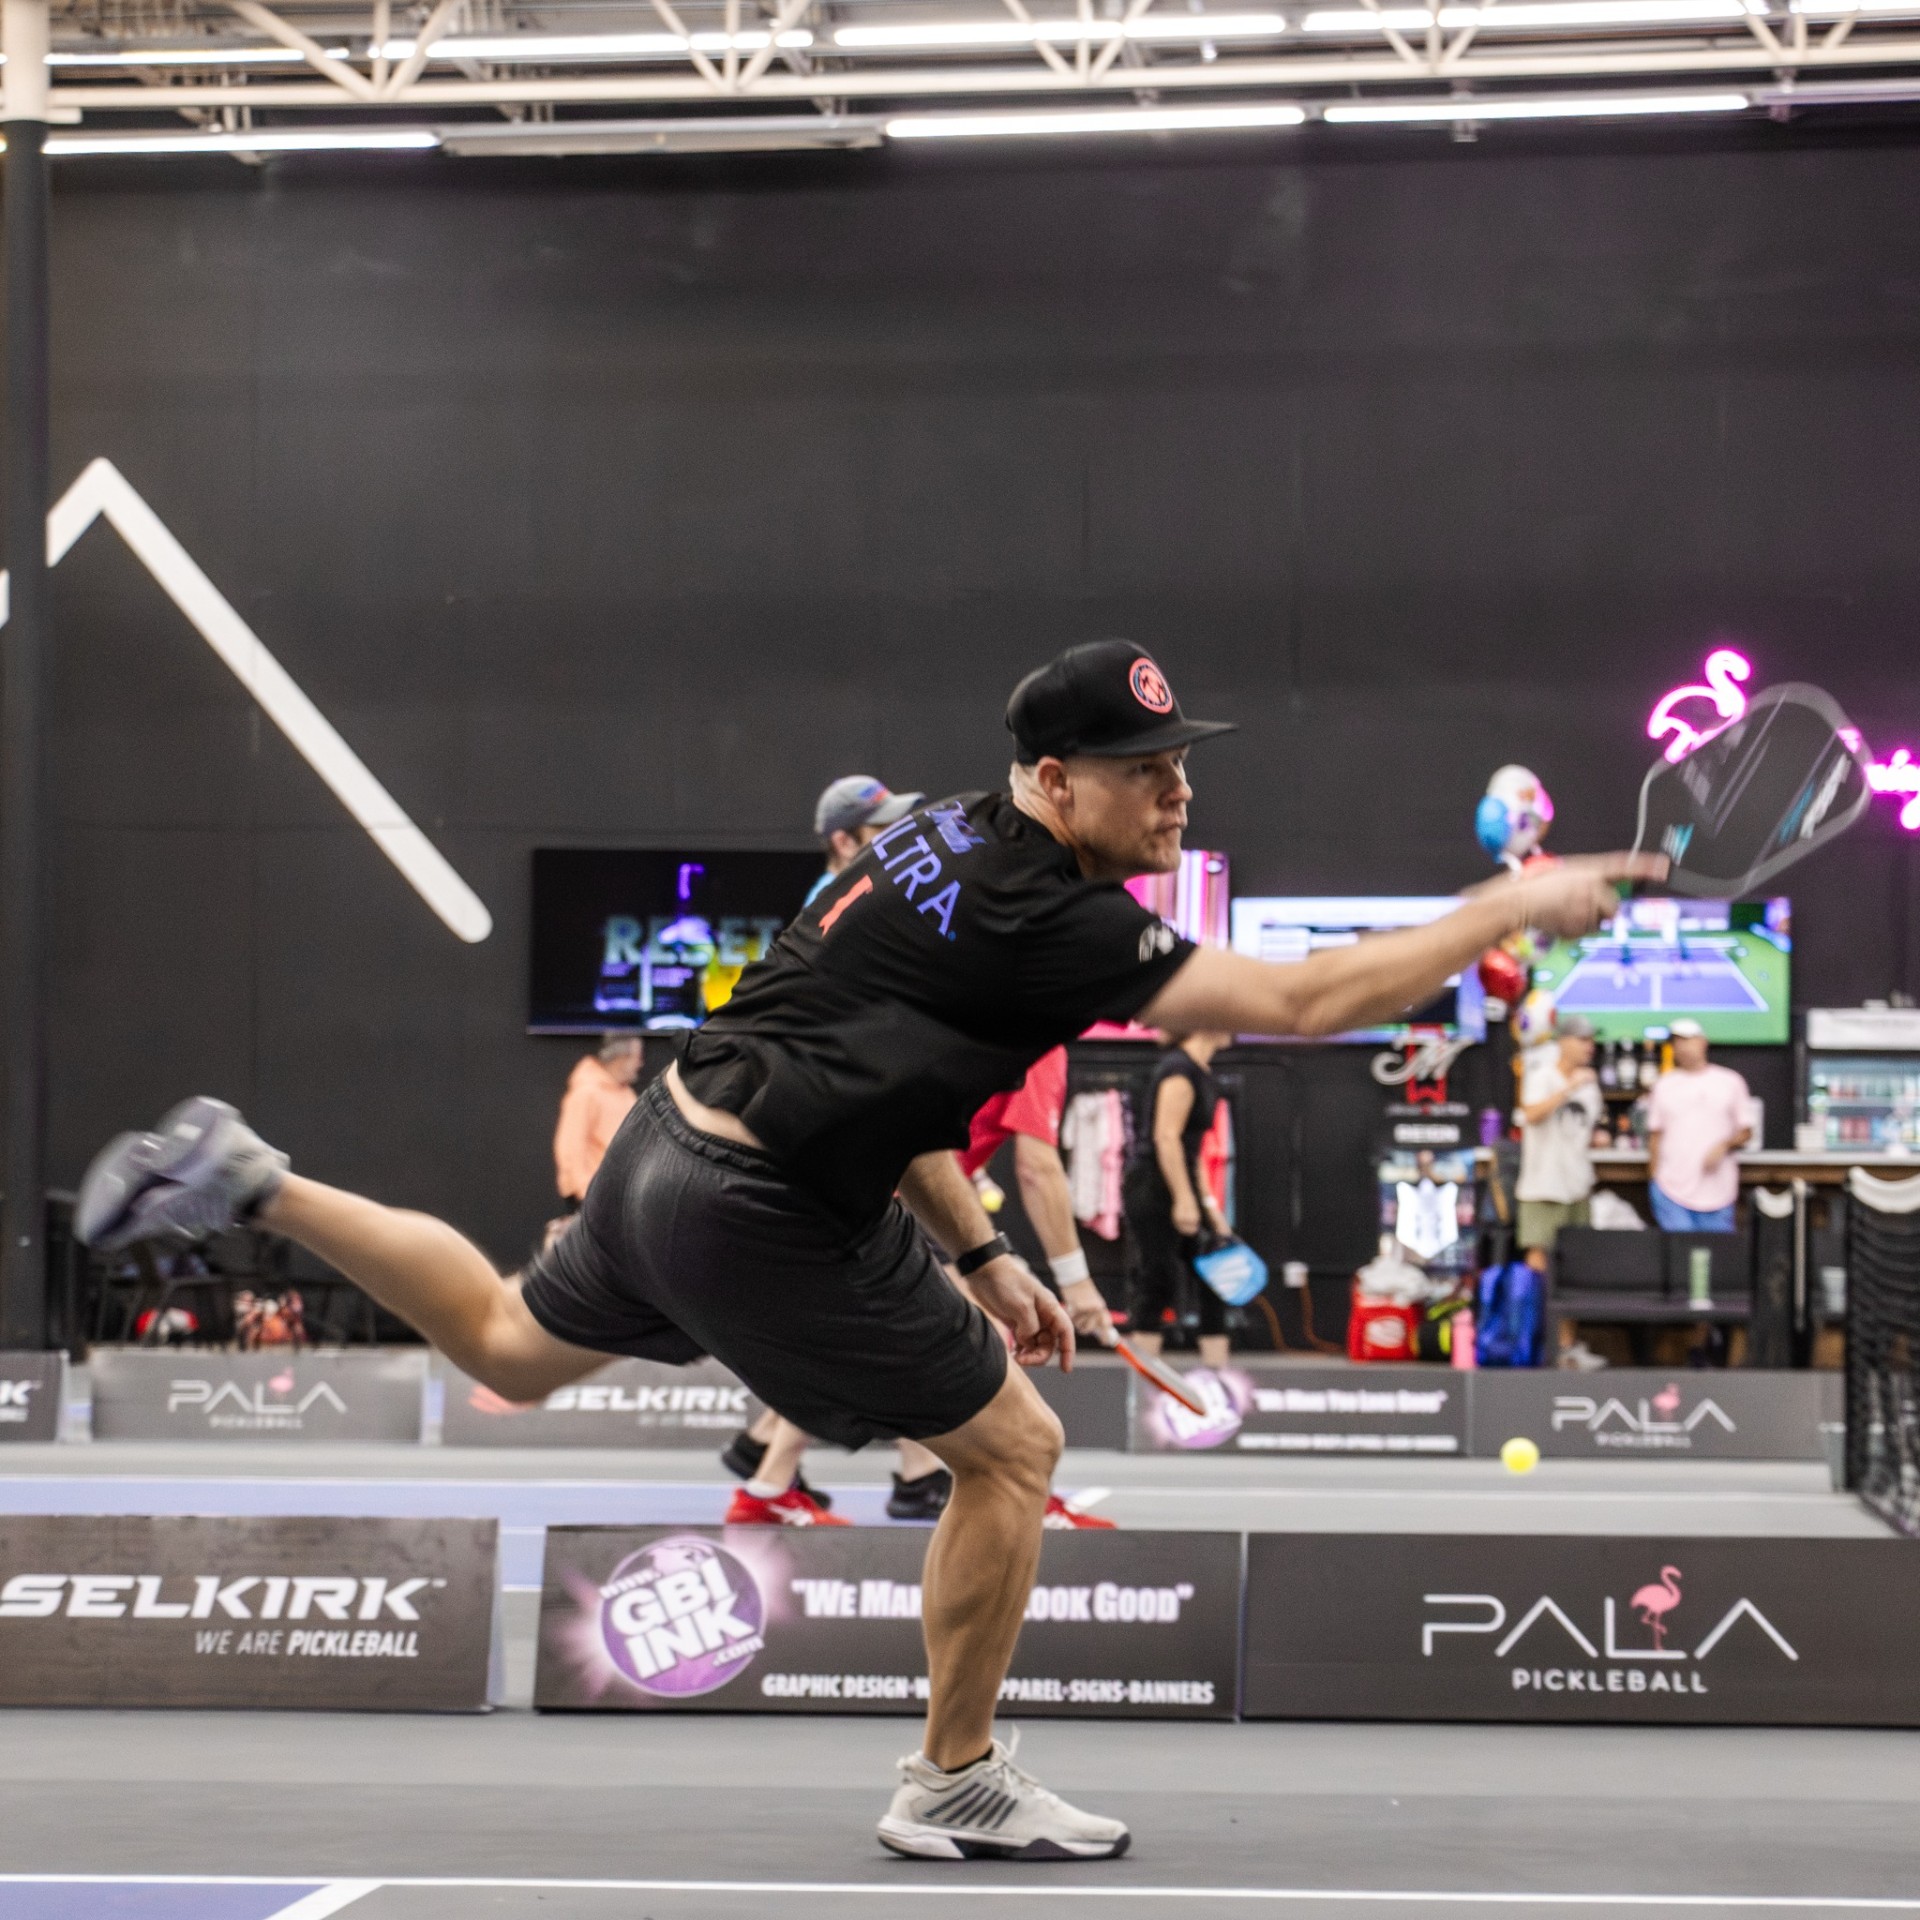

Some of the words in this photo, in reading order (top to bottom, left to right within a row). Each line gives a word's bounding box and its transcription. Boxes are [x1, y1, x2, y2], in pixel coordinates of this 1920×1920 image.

[167, 1379, 348, 1414] PALA
[545, 1385, 750, 1412] SELKIRK
[1551, 1395, 1738, 1433] PALA
[0, 1574, 430, 1620] SELKIRK
[610, 1557, 733, 1636] GBI
[195, 1630, 230, 1655] WE
[236, 1631, 281, 1655] ARE
[286, 1631, 419, 1657] PICKLEBALL
[625, 1593, 755, 1680] INK
[1421, 1593, 1799, 1661] PALA
[761, 1673, 842, 1697] GRAPHIC
[997, 1678, 1064, 1701] PPAREL
[1511, 1668, 1708, 1694] PICKLEBALL
